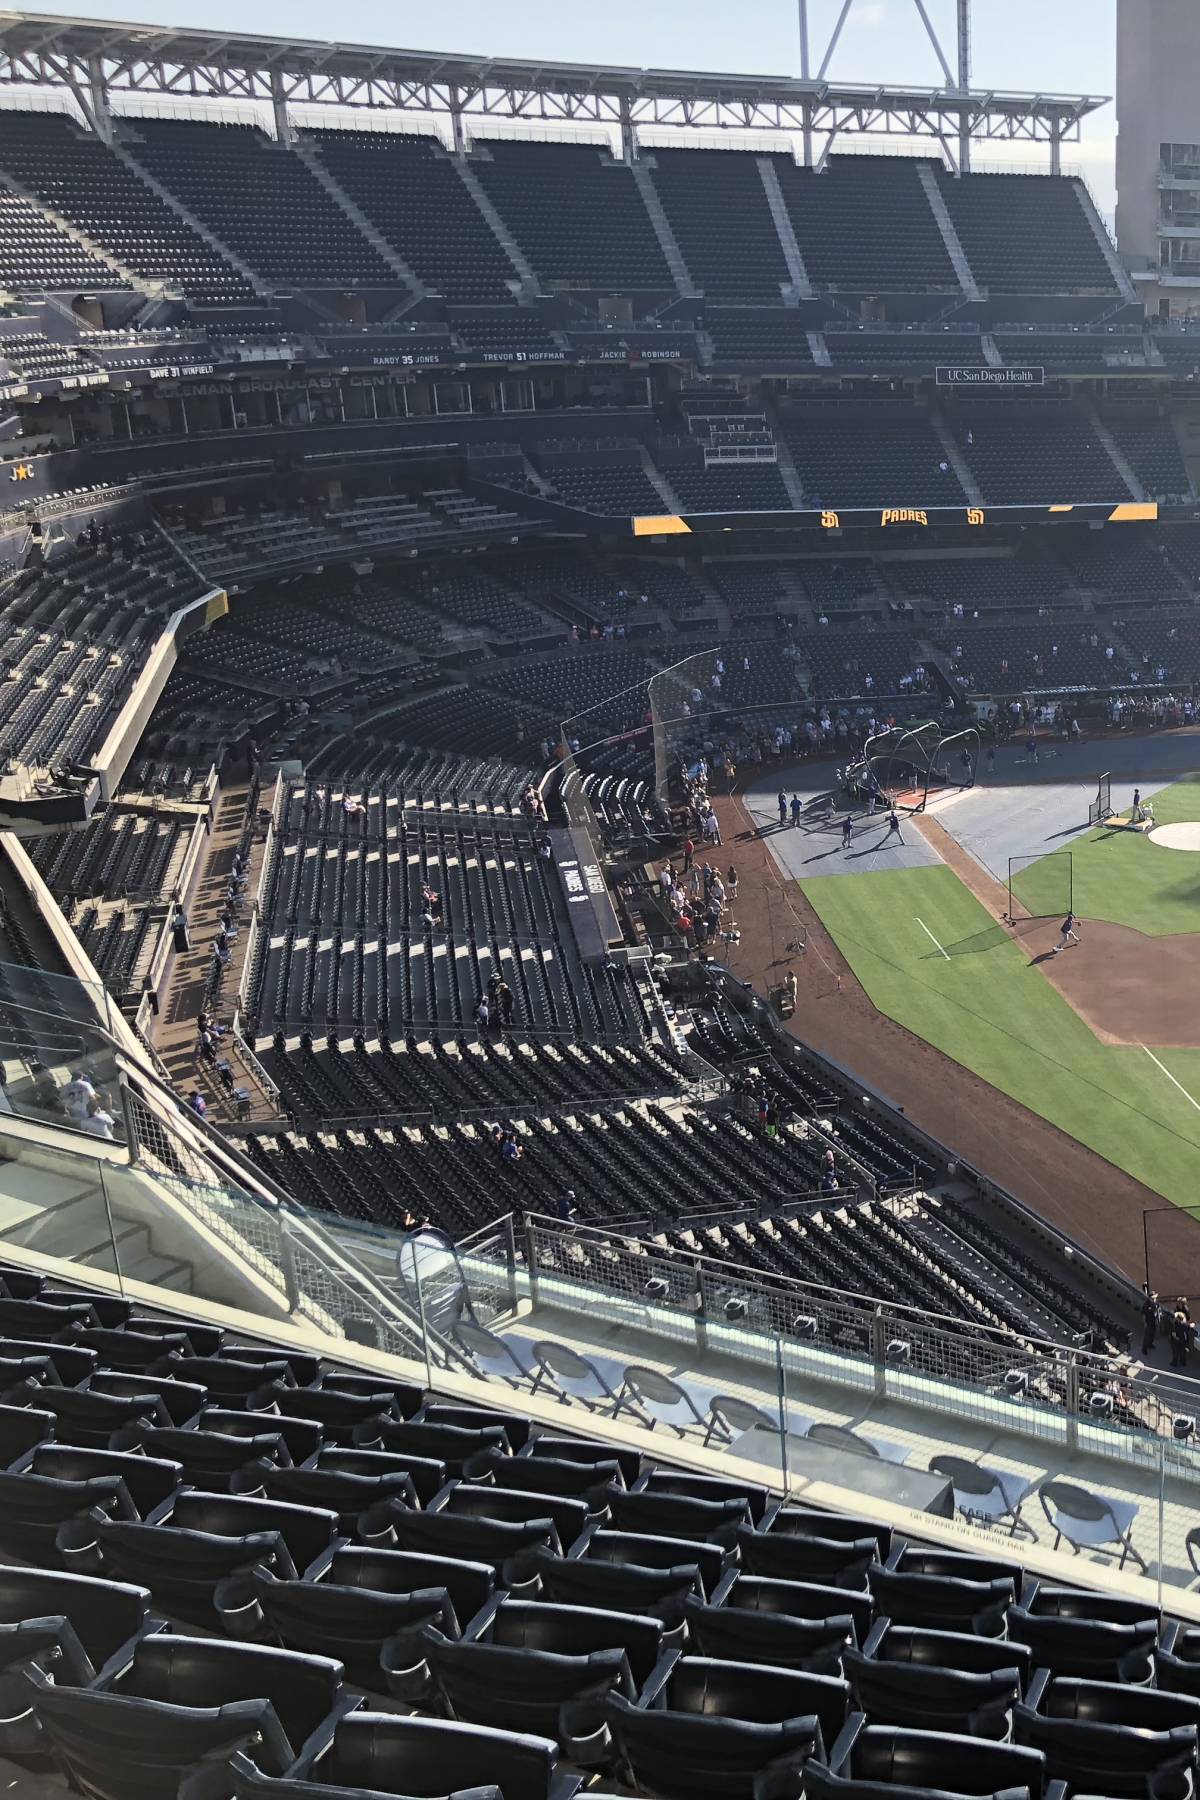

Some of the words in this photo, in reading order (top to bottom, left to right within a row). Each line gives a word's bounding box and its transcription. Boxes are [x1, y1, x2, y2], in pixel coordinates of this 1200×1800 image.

[374, 356, 400, 365] RANDY
[402, 355, 413, 365] 35
[415, 355, 440, 364] JONES
[483, 353, 514, 361] TREVOR
[516, 352, 527, 361] 51
[529, 351, 565, 360] HOFFMAN
[600, 351, 626, 360] JACKIE
[641, 350, 680, 359] ROBINSON
[150, 368, 169, 379] DAVE
[182, 365, 213, 376] WINFIELD
[948, 370, 962, 381] UC
[963, 370, 980, 381] San
[981, 370, 1005, 383] Diego
[1006, 370, 1033, 381] Health
[240, 378, 342, 393] BROADCAST
[352, 375, 417, 386] CENTER
[881, 509, 928, 526] PADRES
